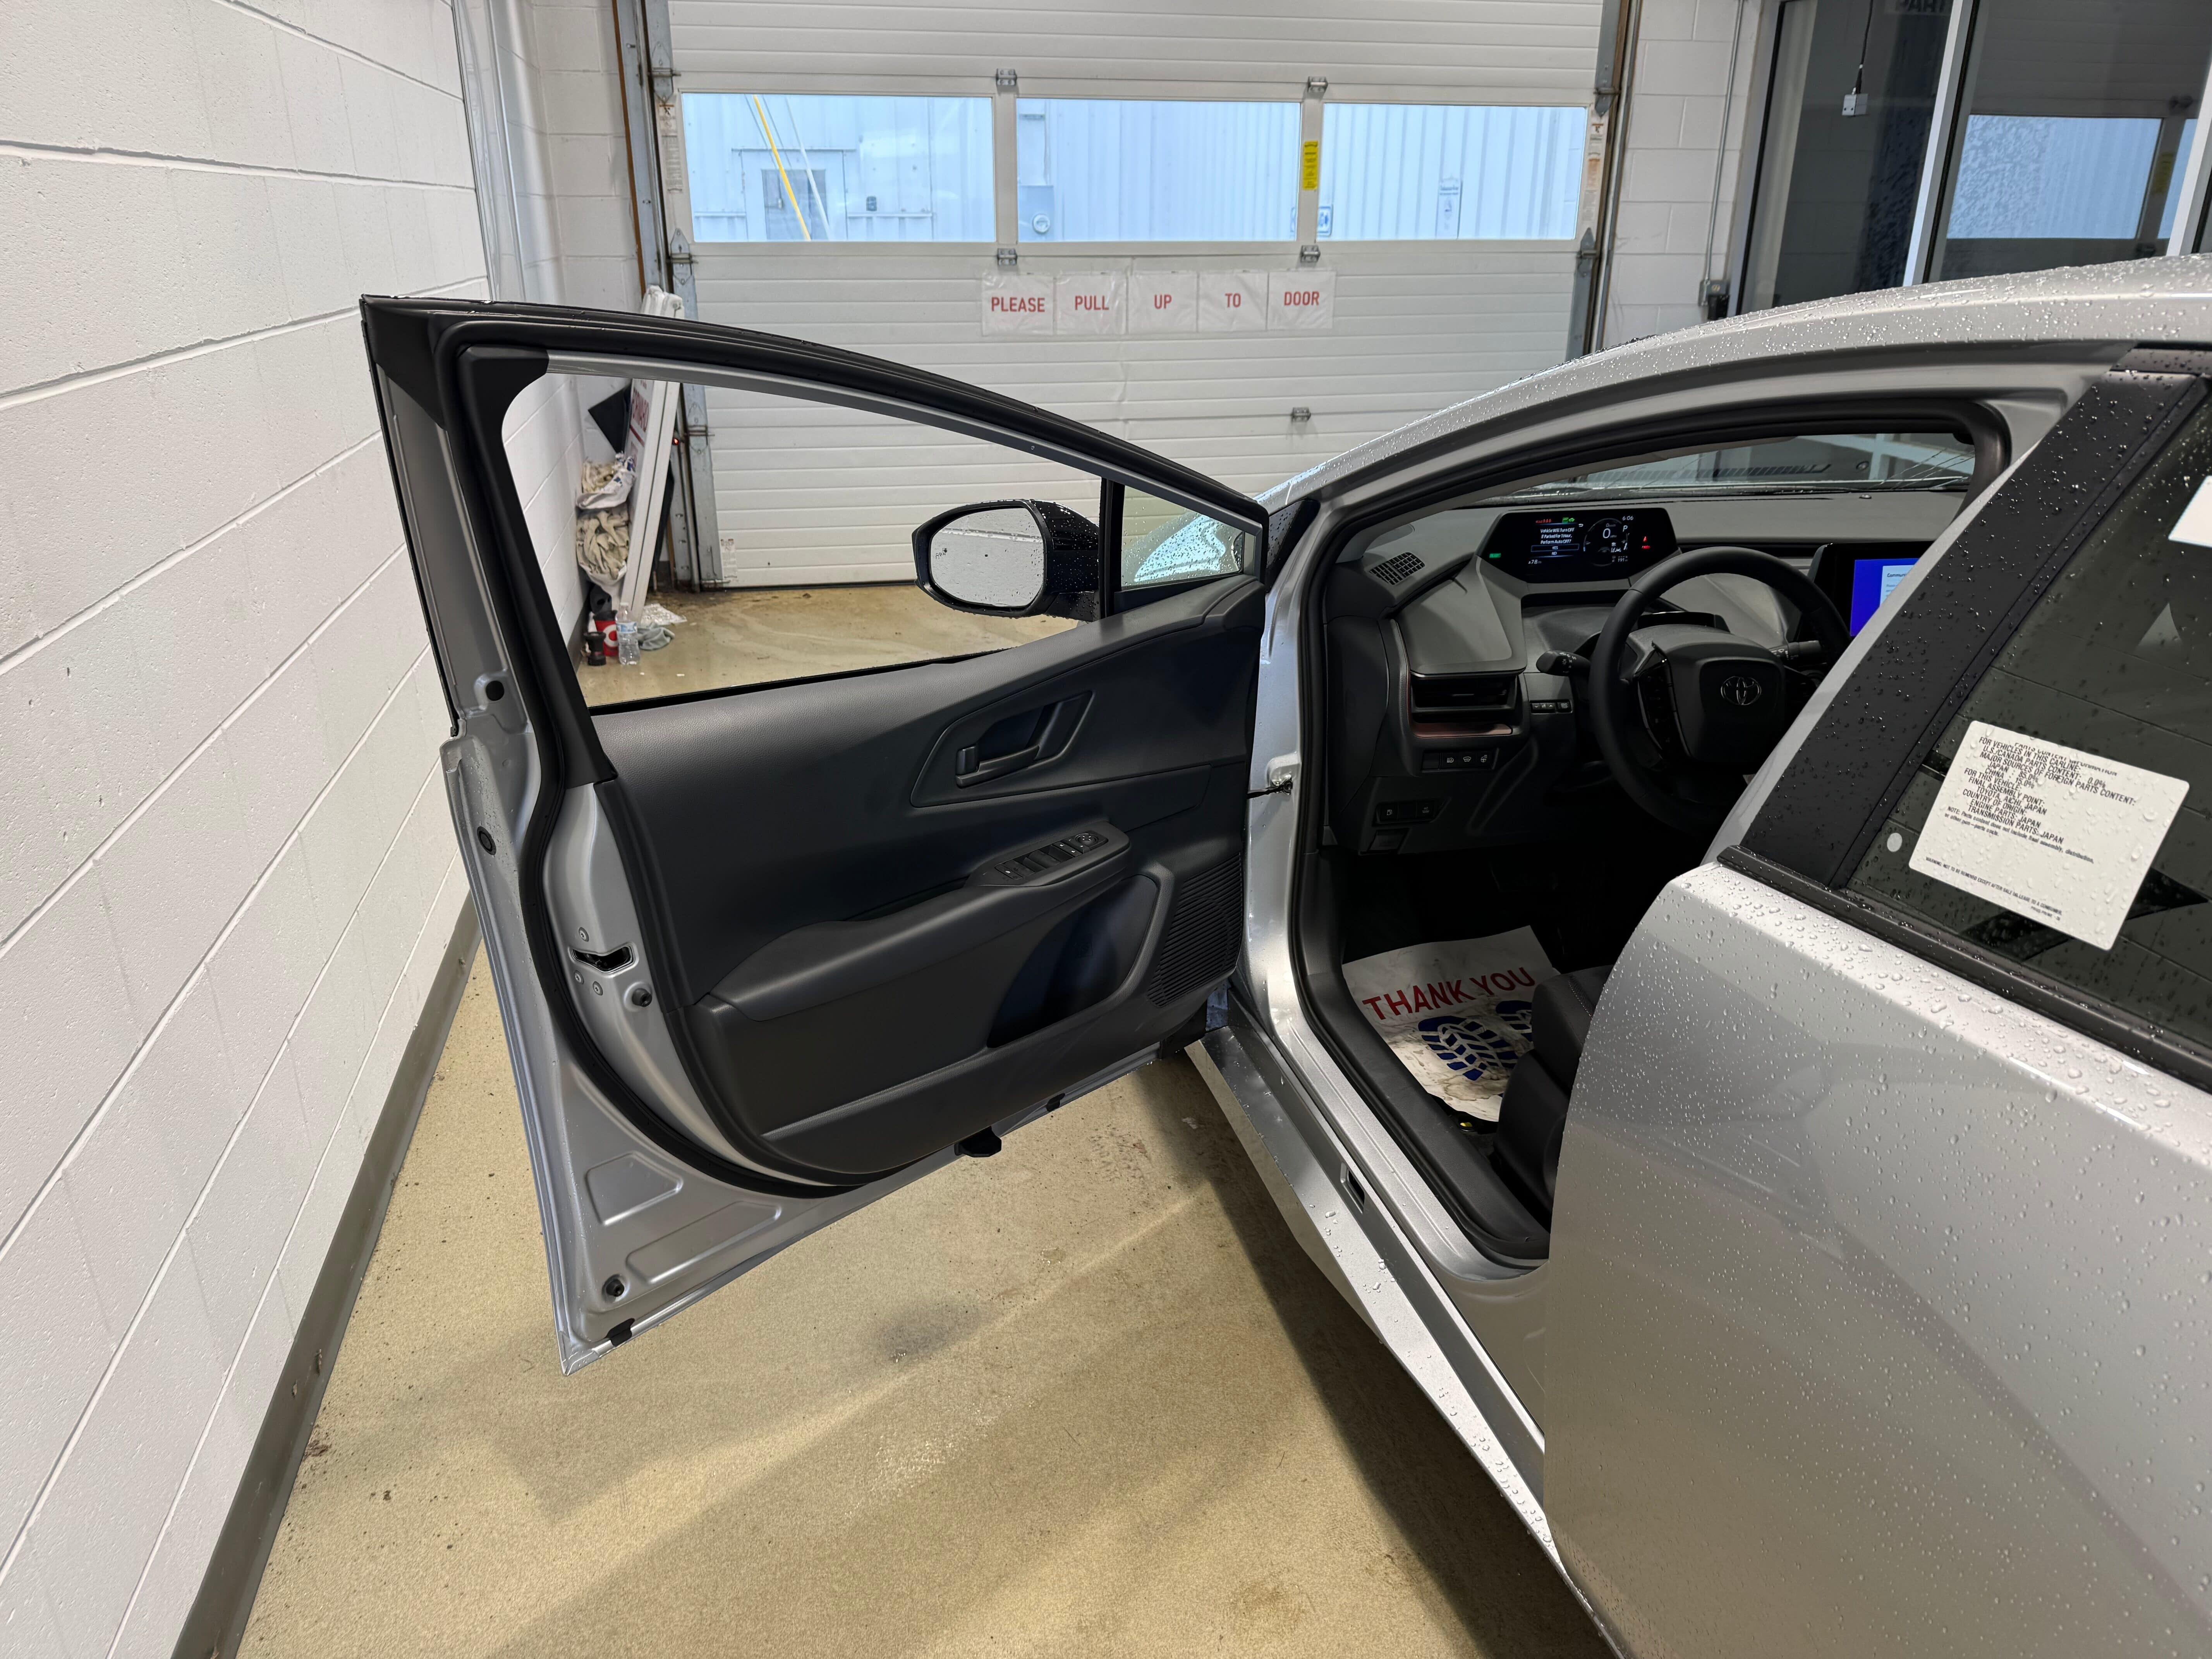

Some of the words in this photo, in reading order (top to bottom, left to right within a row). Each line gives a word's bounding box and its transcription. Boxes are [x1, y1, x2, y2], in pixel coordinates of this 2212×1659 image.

[991, 297, 1046, 313] PLEASE
[1074, 294, 1109, 311] PULL
[1154, 294, 1172, 309] UP
[1225, 293, 1241, 308] TO
[1283, 291, 1320, 306] DOOR
[1602, 528, 1611, 538] 0
[1978, 736, 1992, 746] FOR
[1993, 740, 2023, 755] VEHICLES
[2023, 750, 2032, 758] IN
[2033, 752, 2049, 763] THIS
[2049, 757, 2082, 773] CARLINE:
[1987, 761, 2009, 773] JAPAN
[1964, 768, 1977, 777] FOR
[1978, 771, 1993, 782] THIS
[1994, 777, 2022, 792] VEHICLE:
[1979, 751, 2002, 764] MAJOR
[2002, 758, 2033, 773] SOURCES
[2033, 768, 2044, 776] OF
[2044, 771, 2075, 786] FOREIGN
[2075, 780, 2099, 794] PARTS
[2100, 788, 2136, 806] CONTENT:
[1984, 767, 2004, 779] CHINA
[2015, 777, 2035, 789] 15.0%
[2024, 757, 2047, 770] PARTS
[2047, 764, 2081, 781] CONTENT:
[2087, 776, 2106, 789] 0.0%
[1963, 788, 1992, 804] COUNTRY
[1992, 799, 2002, 807] OF
[2002, 802, 2027, 816] ORIGIN:
[1968, 776, 1985, 788] FINAL
[1987, 782, 2022, 799] ASSEMBLY
[2022, 794, 2045, 807] POINT:
[1970, 799, 1994, 812] ENGINE
[1994, 807, 2018, 821] PARTS:
[2018, 816, 2041, 829] JAPAN
[2024, 802, 2047, 816] JAPAN
[1968, 804, 2015, 827] TRANSMISSION
[2015, 821, 2039, 836] PARTS:
[2040, 831, 2064, 845] JAPAN
[1362, 979, 1476, 1020] THANK
[1468, 967, 1536, 996] YOU
